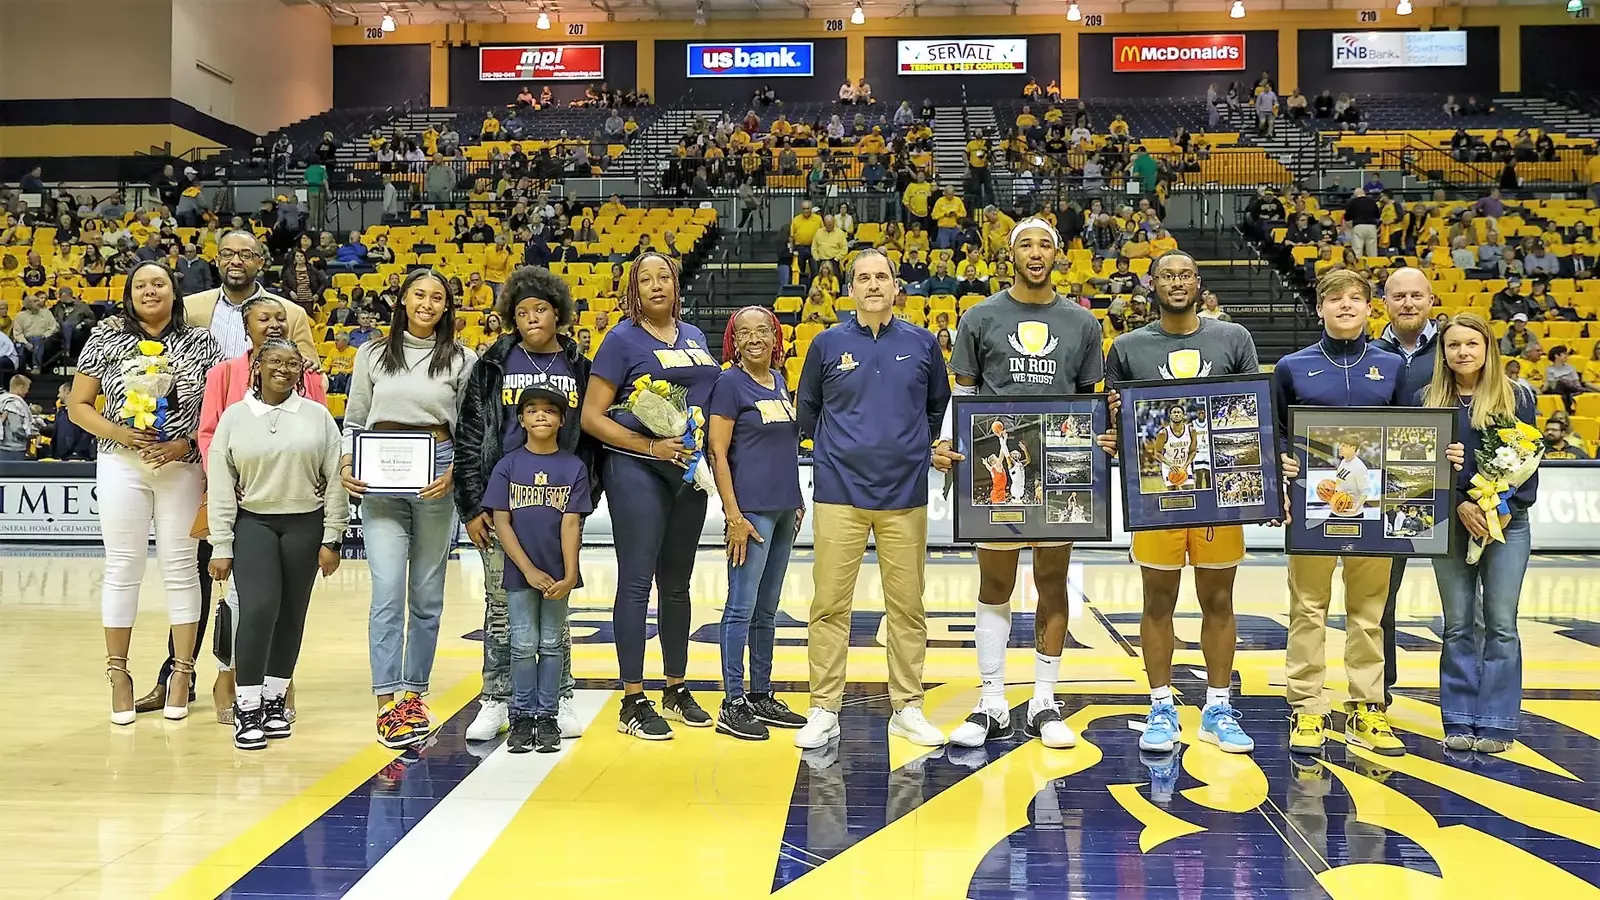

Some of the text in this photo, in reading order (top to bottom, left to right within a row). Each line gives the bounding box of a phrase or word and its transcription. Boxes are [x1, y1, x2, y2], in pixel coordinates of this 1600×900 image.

[1085, 15, 1102, 26] 209
[1361, 11, 1377, 22] 210
[568, 24, 584, 35] 207
[826, 19, 843, 31] 208
[366, 28, 383, 39] 206
[520, 47, 564, 67] mpi
[927, 42, 995, 61] SERVALL
[1141, 46, 1240, 61] McDonald's
[1336, 46, 1394, 60] FNB Bank
[910, 63, 944, 71] TERMITE
[945, 63, 953, 71] &
[977, 62, 1015, 70] CONTROL
[1009, 357, 1057, 375] IN ROD
[1012, 372, 1054, 385] WE TRUST
[1173, 447, 1187, 460] 25
[509, 481, 572, 513] MURRAY STATE
